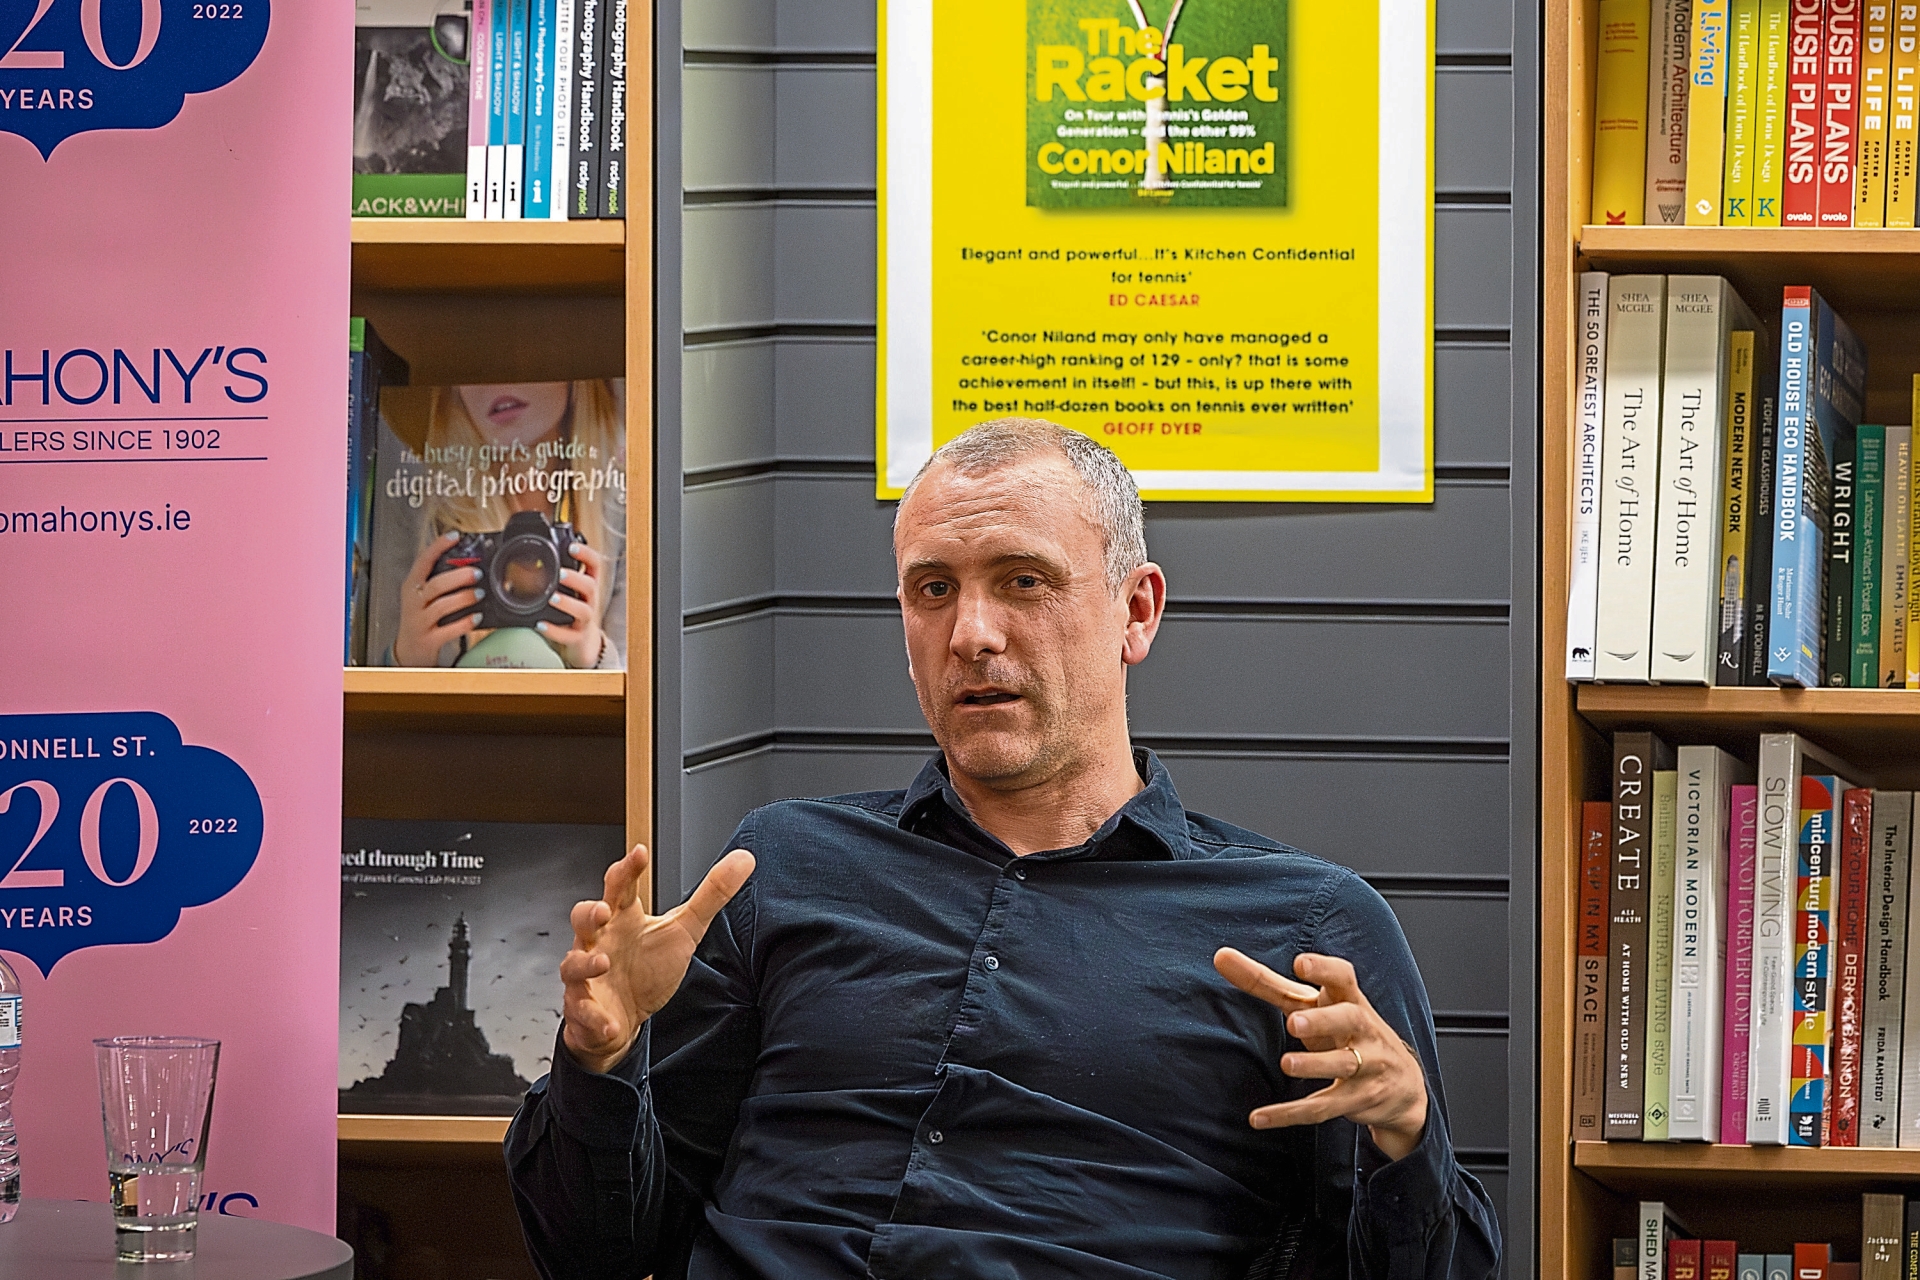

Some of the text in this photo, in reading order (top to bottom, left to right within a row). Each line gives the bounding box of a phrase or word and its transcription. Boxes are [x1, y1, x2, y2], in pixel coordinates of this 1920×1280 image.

[192, 4, 243, 19] 2022
[1078, 18, 1164, 56] The
[1693, 12, 1722, 86] Living
[493, 71, 504, 117] SHADOW
[556, 38, 568, 147] YOUR PHOTO LIFE
[1035, 44, 1279, 102] Racket
[1669, 0, 1690, 165] Modern Architecture
[0, 89, 94, 109] YEARS
[535, 84, 545, 116] Course
[1064, 108, 1250, 122] On Tour Golden
[1731, 11, 1752, 183] The Handbook Home Design
[1864, 67, 1884, 130] LIFE
[576, 80, 595, 215] Handbook rockynook
[1056, 124, 1257, 138] Generation the other 99%
[1788, 83, 1817, 184] PLANS
[1037, 141, 1276, 175] Conor Niland
[1861, 140, 1870, 203] HUNTINGTON
[1786, 211, 1814, 222] ovolo
[961, 247, 1355, 263] Elegant and Kitchen Confidential
[1111, 271, 1193, 284] for tennis'
[1108, 294, 1201, 307] ED CAESAR
[1616, 303, 1654, 313] MCGEE
[1621, 293, 1650, 302] SHEA
[1042, 330, 1096, 344] Niland
[1101, 332, 1138, 346] may
[1143, 332, 1178, 345] only
[1183, 332, 1225, 344] have
[1230, 332, 1312, 348] managed
[1317, 333, 1329, 344] a
[1786, 321, 1804, 353] OLD
[0, 345, 270, 406] HONY'S
[961, 353, 1350, 370] career-high ranking of 129 only? that is some
[952, 399, 1354, 413] the best half-dozen books on tennis ever written'
[958, 377, 1067, 389] achievement
[1154, 377, 1182, 390] but
[1187, 377, 1221, 392] this,
[1225, 377, 1238, 390] is
[1243, 379, 1265, 392] up
[1270, 377, 1313, 390] there
[1317, 377, 1353, 390] with
[1580, 288, 1601, 515] THE 50 GREATEST ARCHITECTS
[1785, 358, 1802, 412] HOUSE
[72, 430, 153, 451] SINCE
[163, 429, 221, 450] 1902
[1102, 422, 1203, 435] GEOFF DYER
[1732, 391, 1746, 453] MODERN
[1783, 417, 1799, 449] ECO
[424, 434, 587, 471] busy girl's guide
[1730, 457, 1744, 492] NEW
[1759, 397, 1773, 516] PEOPLE GLASSHOUSES
[1897, 442, 1909, 491] HEAVEN
[386, 456, 626, 509] digital photography
[1615, 387, 1643, 567] The Art of Home
[1779, 453, 1798, 542] HANDBOOK
[1728, 495, 1743, 533] YORK
[1832, 461, 1853, 563] WRIGHT
[1863, 489, 1876, 536] Landscape
[1861, 582, 1873, 612] Pocket
[1893, 564, 1905, 654] EMMA WELLS
[1861, 613, 1873, 636] Book
[112, 736, 156, 757] ST.
[189, 818, 239, 834] 2022
[1617, 755, 1643, 891] CREATE
[368, 849, 485, 872] through Time
[1684, 769, 1701, 957] VICTORIAN MODERN
[1760, 777, 1786, 938] SLOW LIVING
[1806, 813, 1826, 911] midcentury
[1848, 850, 1861, 895] YOUR
[0, 906, 94, 929] YEARS
[1734, 799, 1757, 1038] YOUR NOT FOREVER HOME
[1845, 899, 1859, 948] HOME
[1878, 825, 1897, 1002] The Interior Design Handbook
[1585, 924, 1600, 951] MY
[1805, 913, 1822, 979] modern
[1583, 960, 1599, 1023] SPACE
[1652, 894, 1670, 1076] NATURAL LIVING style
[1801, 981, 1819, 1030] style
[1620, 943, 1631, 1090] AT HOME WITH OLD NEW
[1874, 1027, 1885, 1102] FRIDA RAMSTEDT
[1645, 1219, 1658, 1257] SHED
[1866, 1236, 1899, 1245] Jackson
[1874, 1252, 1891, 1263] Day
